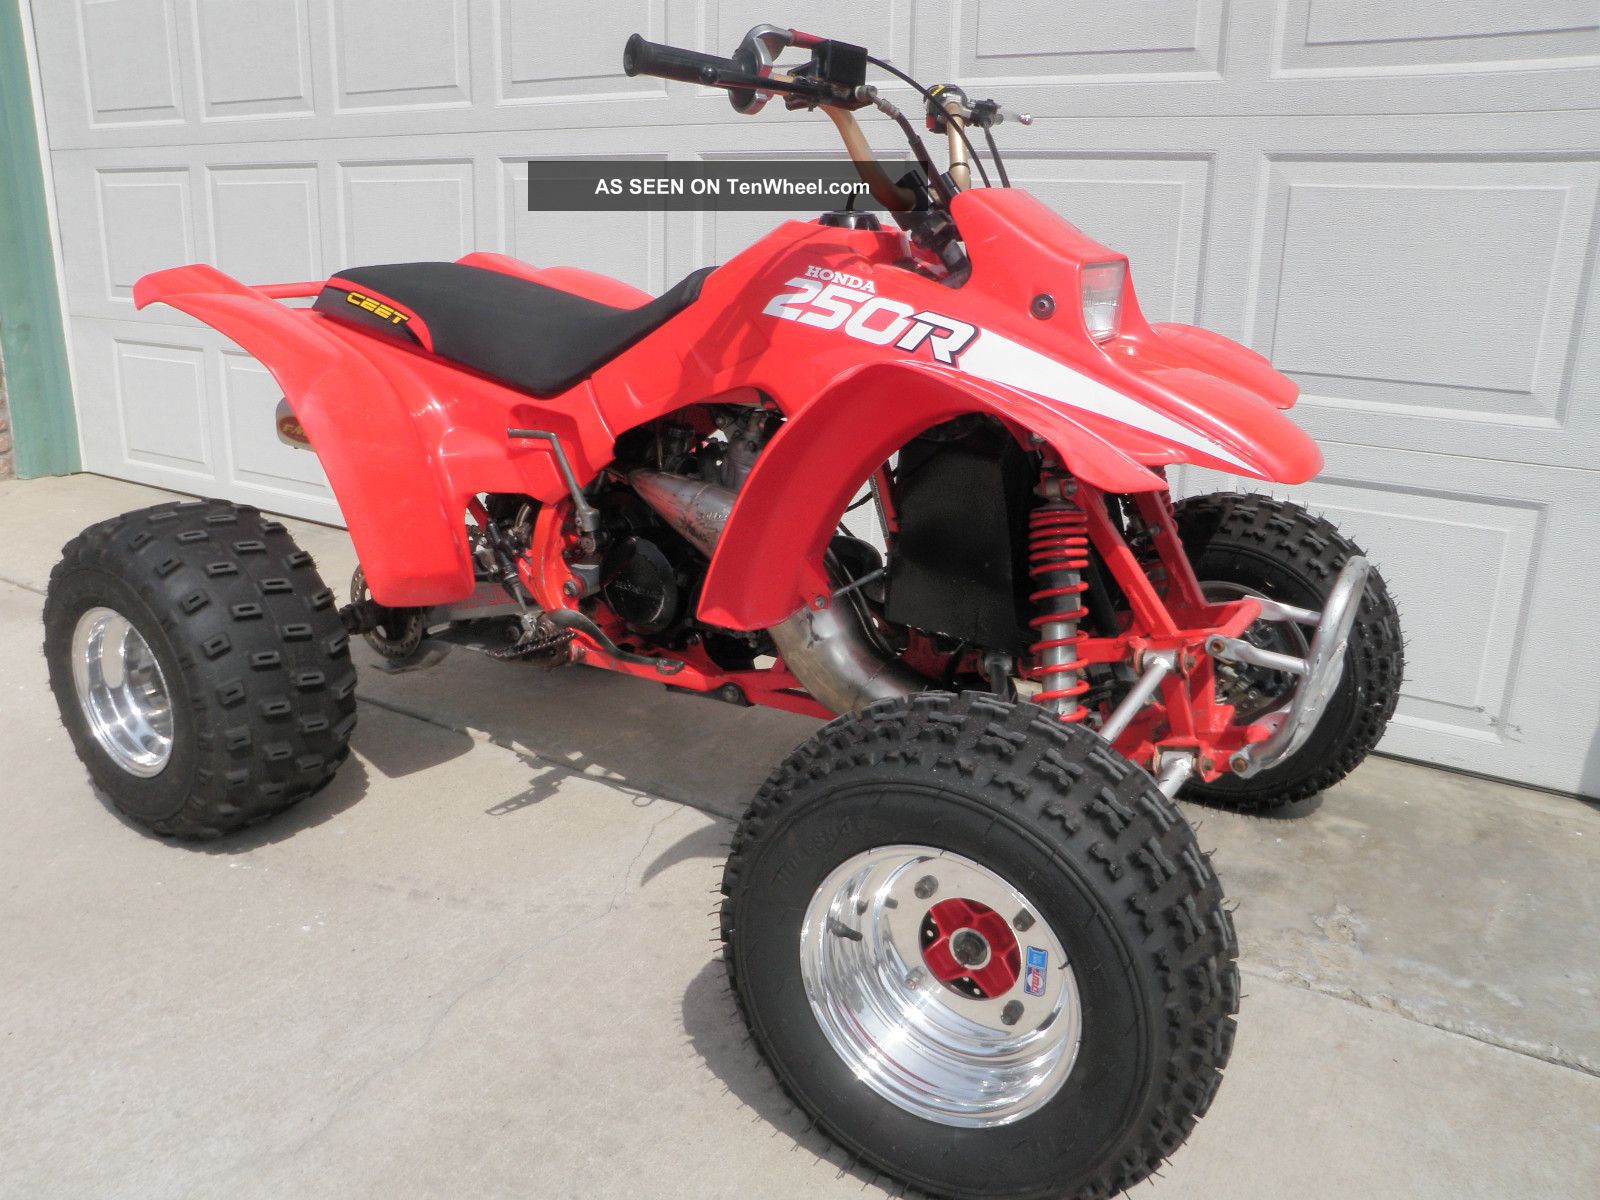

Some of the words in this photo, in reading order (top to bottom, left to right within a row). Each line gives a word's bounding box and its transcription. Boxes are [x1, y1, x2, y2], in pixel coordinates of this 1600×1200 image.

[805, 265, 876, 294] HONDA
[346, 291, 410, 324] CEET
[761, 276, 979, 369] 250R
